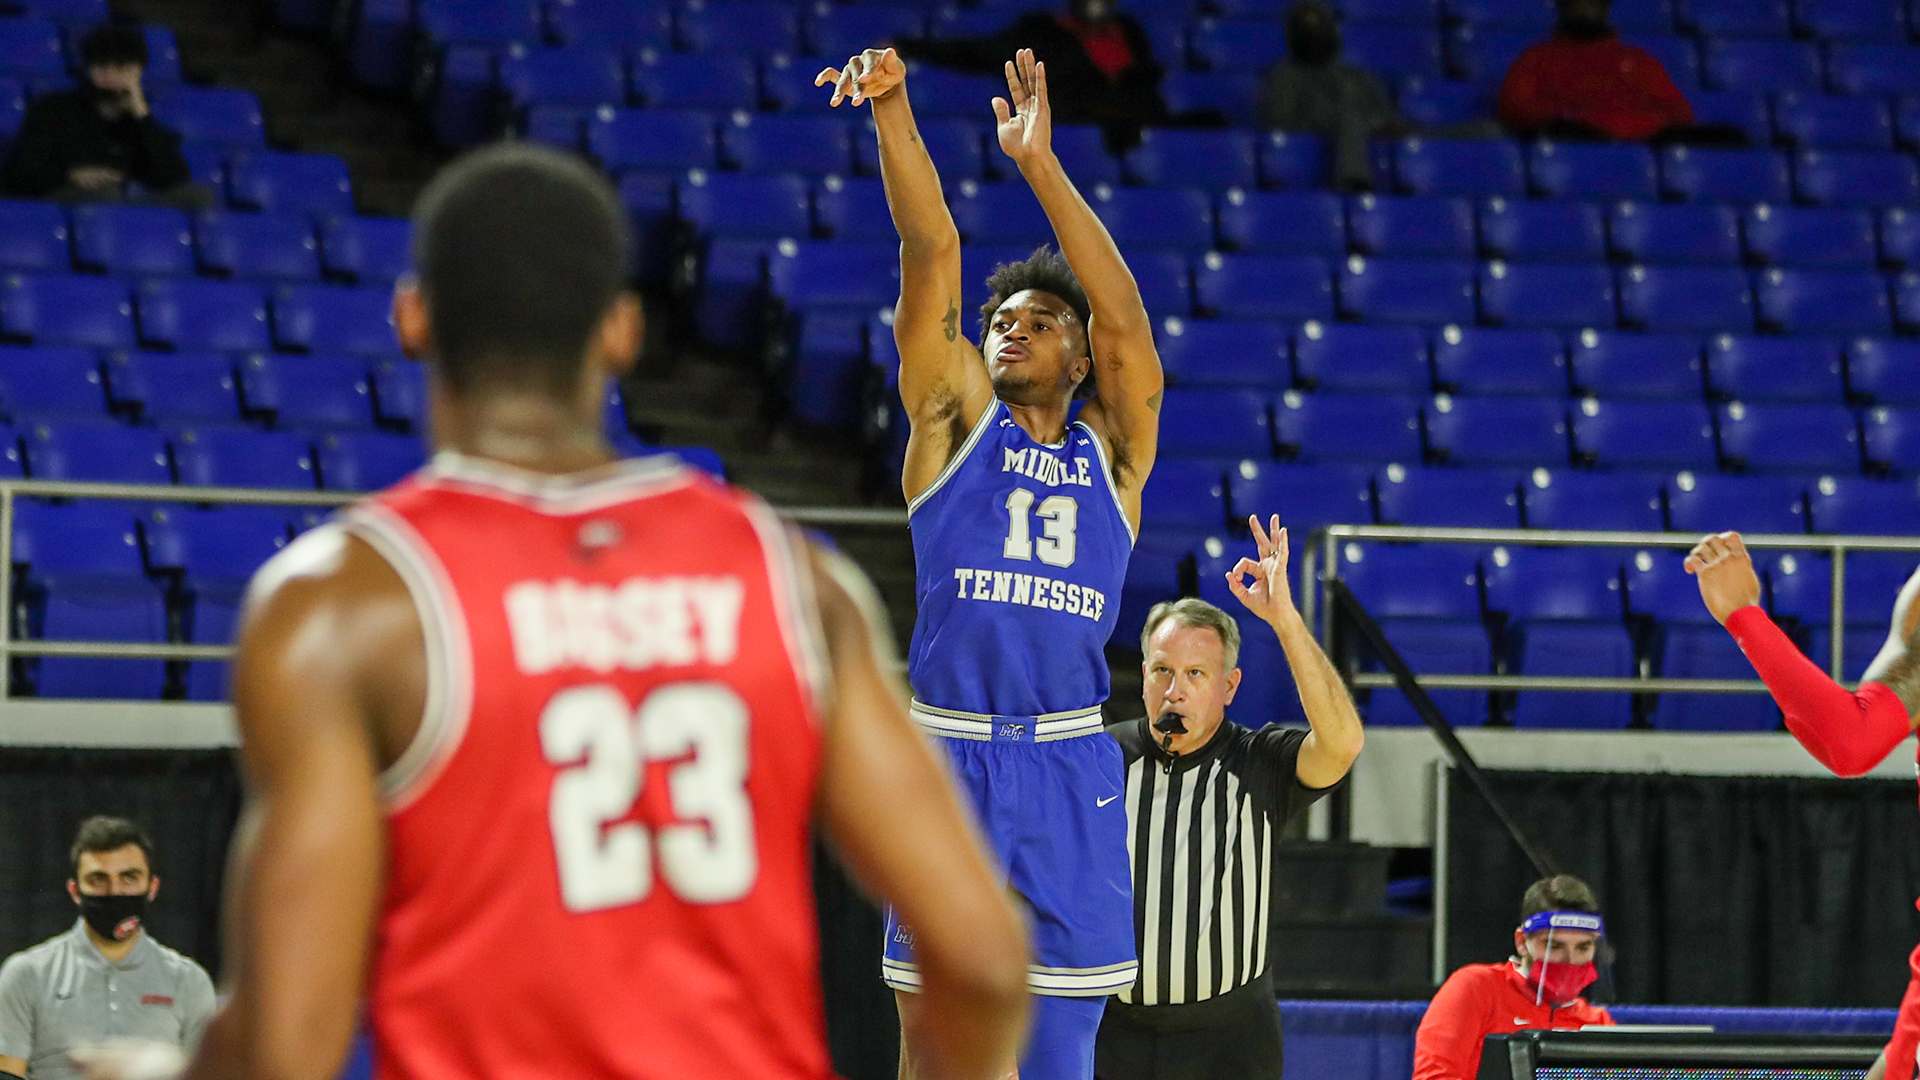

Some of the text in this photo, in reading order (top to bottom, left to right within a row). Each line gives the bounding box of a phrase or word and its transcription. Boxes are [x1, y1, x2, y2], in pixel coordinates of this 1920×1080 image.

[1002, 447, 1092, 487] MIDDLE
[1003, 487, 1078, 568] 13
[954, 568, 1106, 622] TENNESSEE
[539, 683, 758, 912] 23
